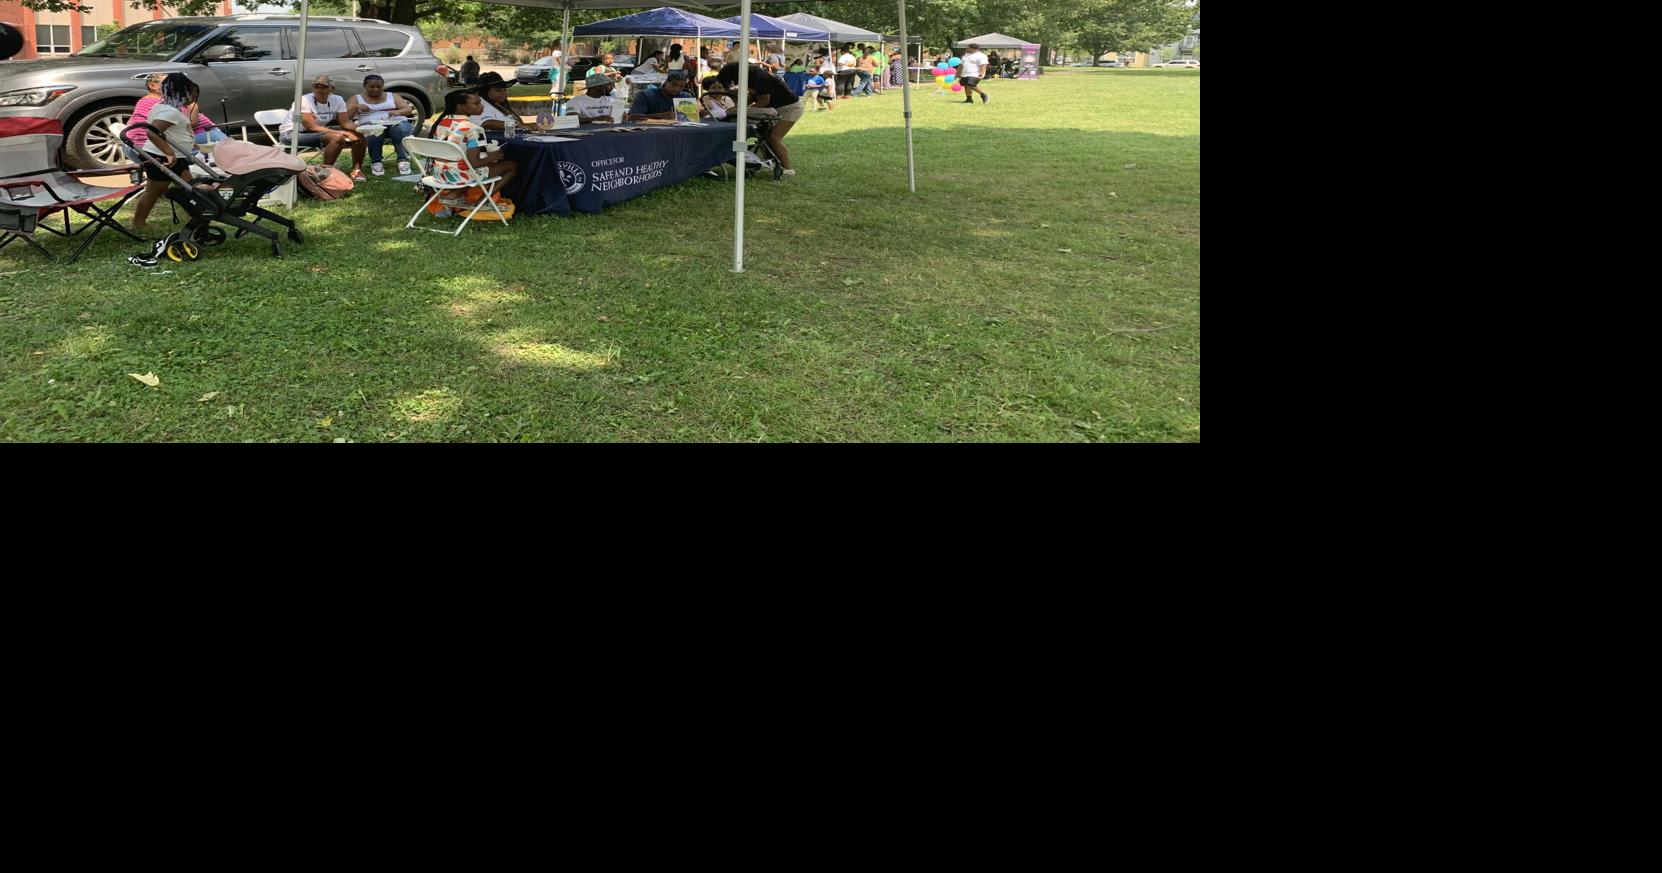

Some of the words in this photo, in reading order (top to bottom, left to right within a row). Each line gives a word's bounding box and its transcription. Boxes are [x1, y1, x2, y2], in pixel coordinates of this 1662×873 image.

[591, 168, 664, 191] NEIGHBORHOODS
[592, 170, 614, 182] SAFE
[615, 166, 633, 178] AND
[636, 160, 669, 174] HEALTHY
